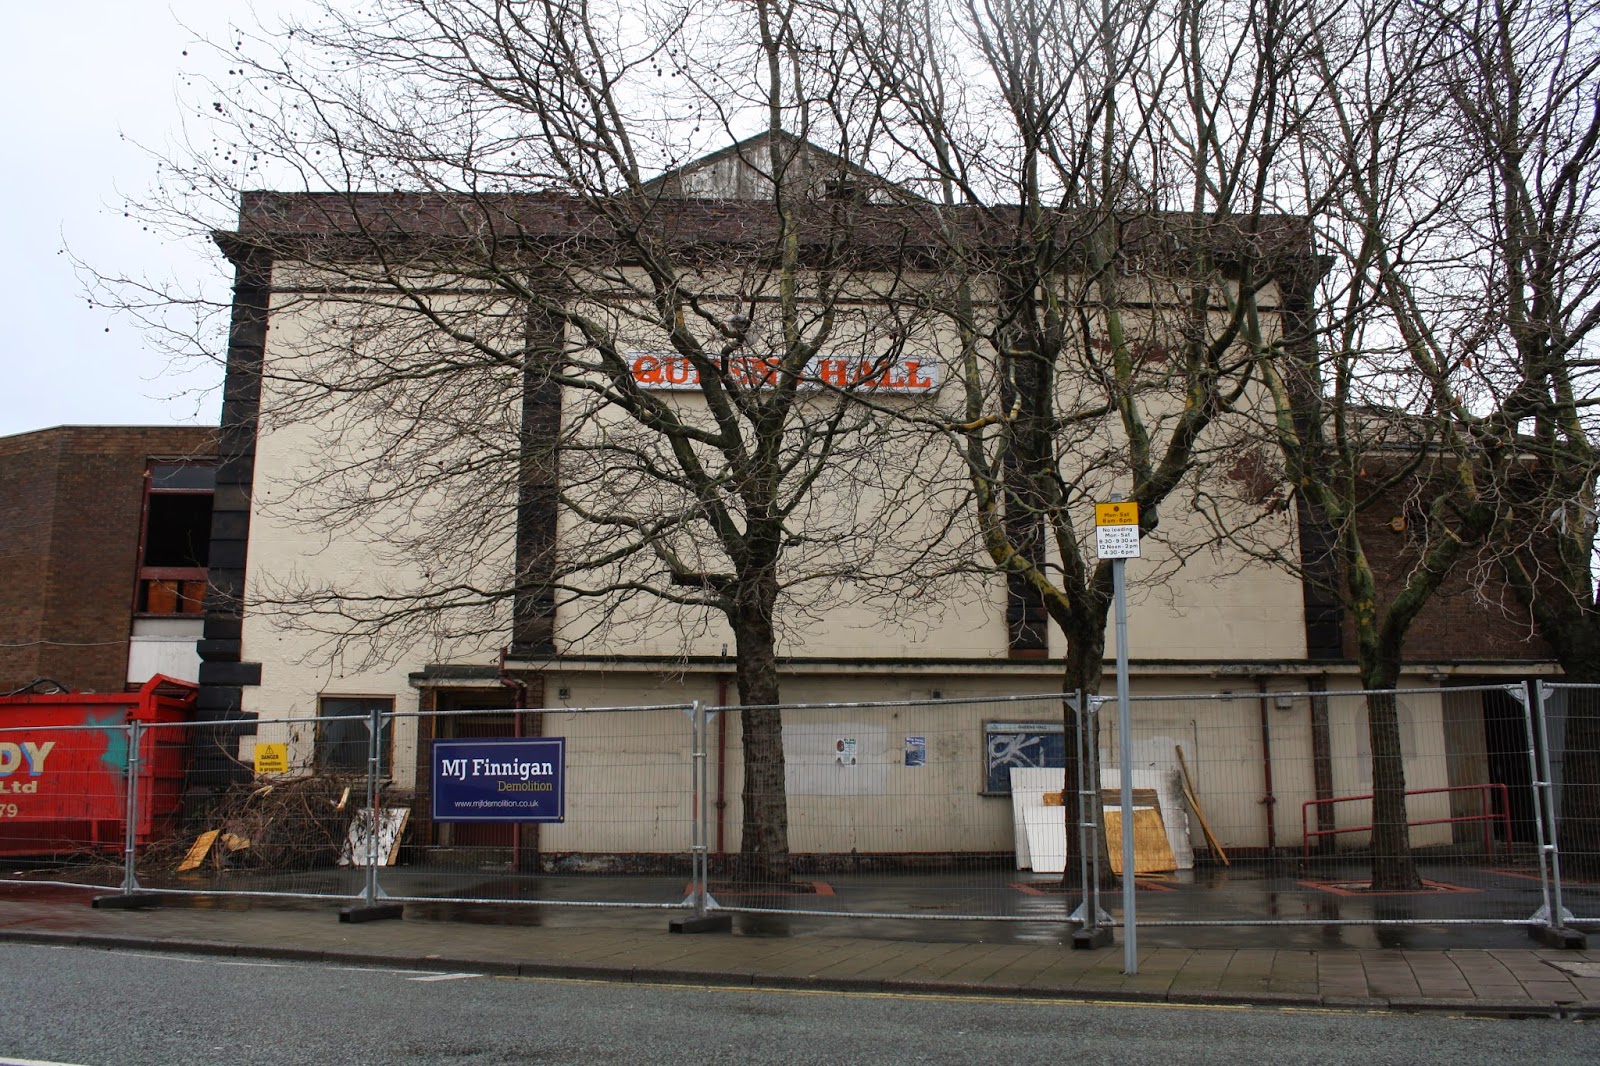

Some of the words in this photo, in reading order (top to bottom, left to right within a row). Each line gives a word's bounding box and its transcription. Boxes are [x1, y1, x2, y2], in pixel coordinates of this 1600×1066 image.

[819, 360, 931, 388] HALL
[441, 759, 468, 780] MJ
[472, 758, 553, 780] Finnigan
[0, 781, 38, 794] Ltd
[498, 780, 553, 791] Demolition
[454, 800, 539, 808] www.mjfdemolition.co.uk
